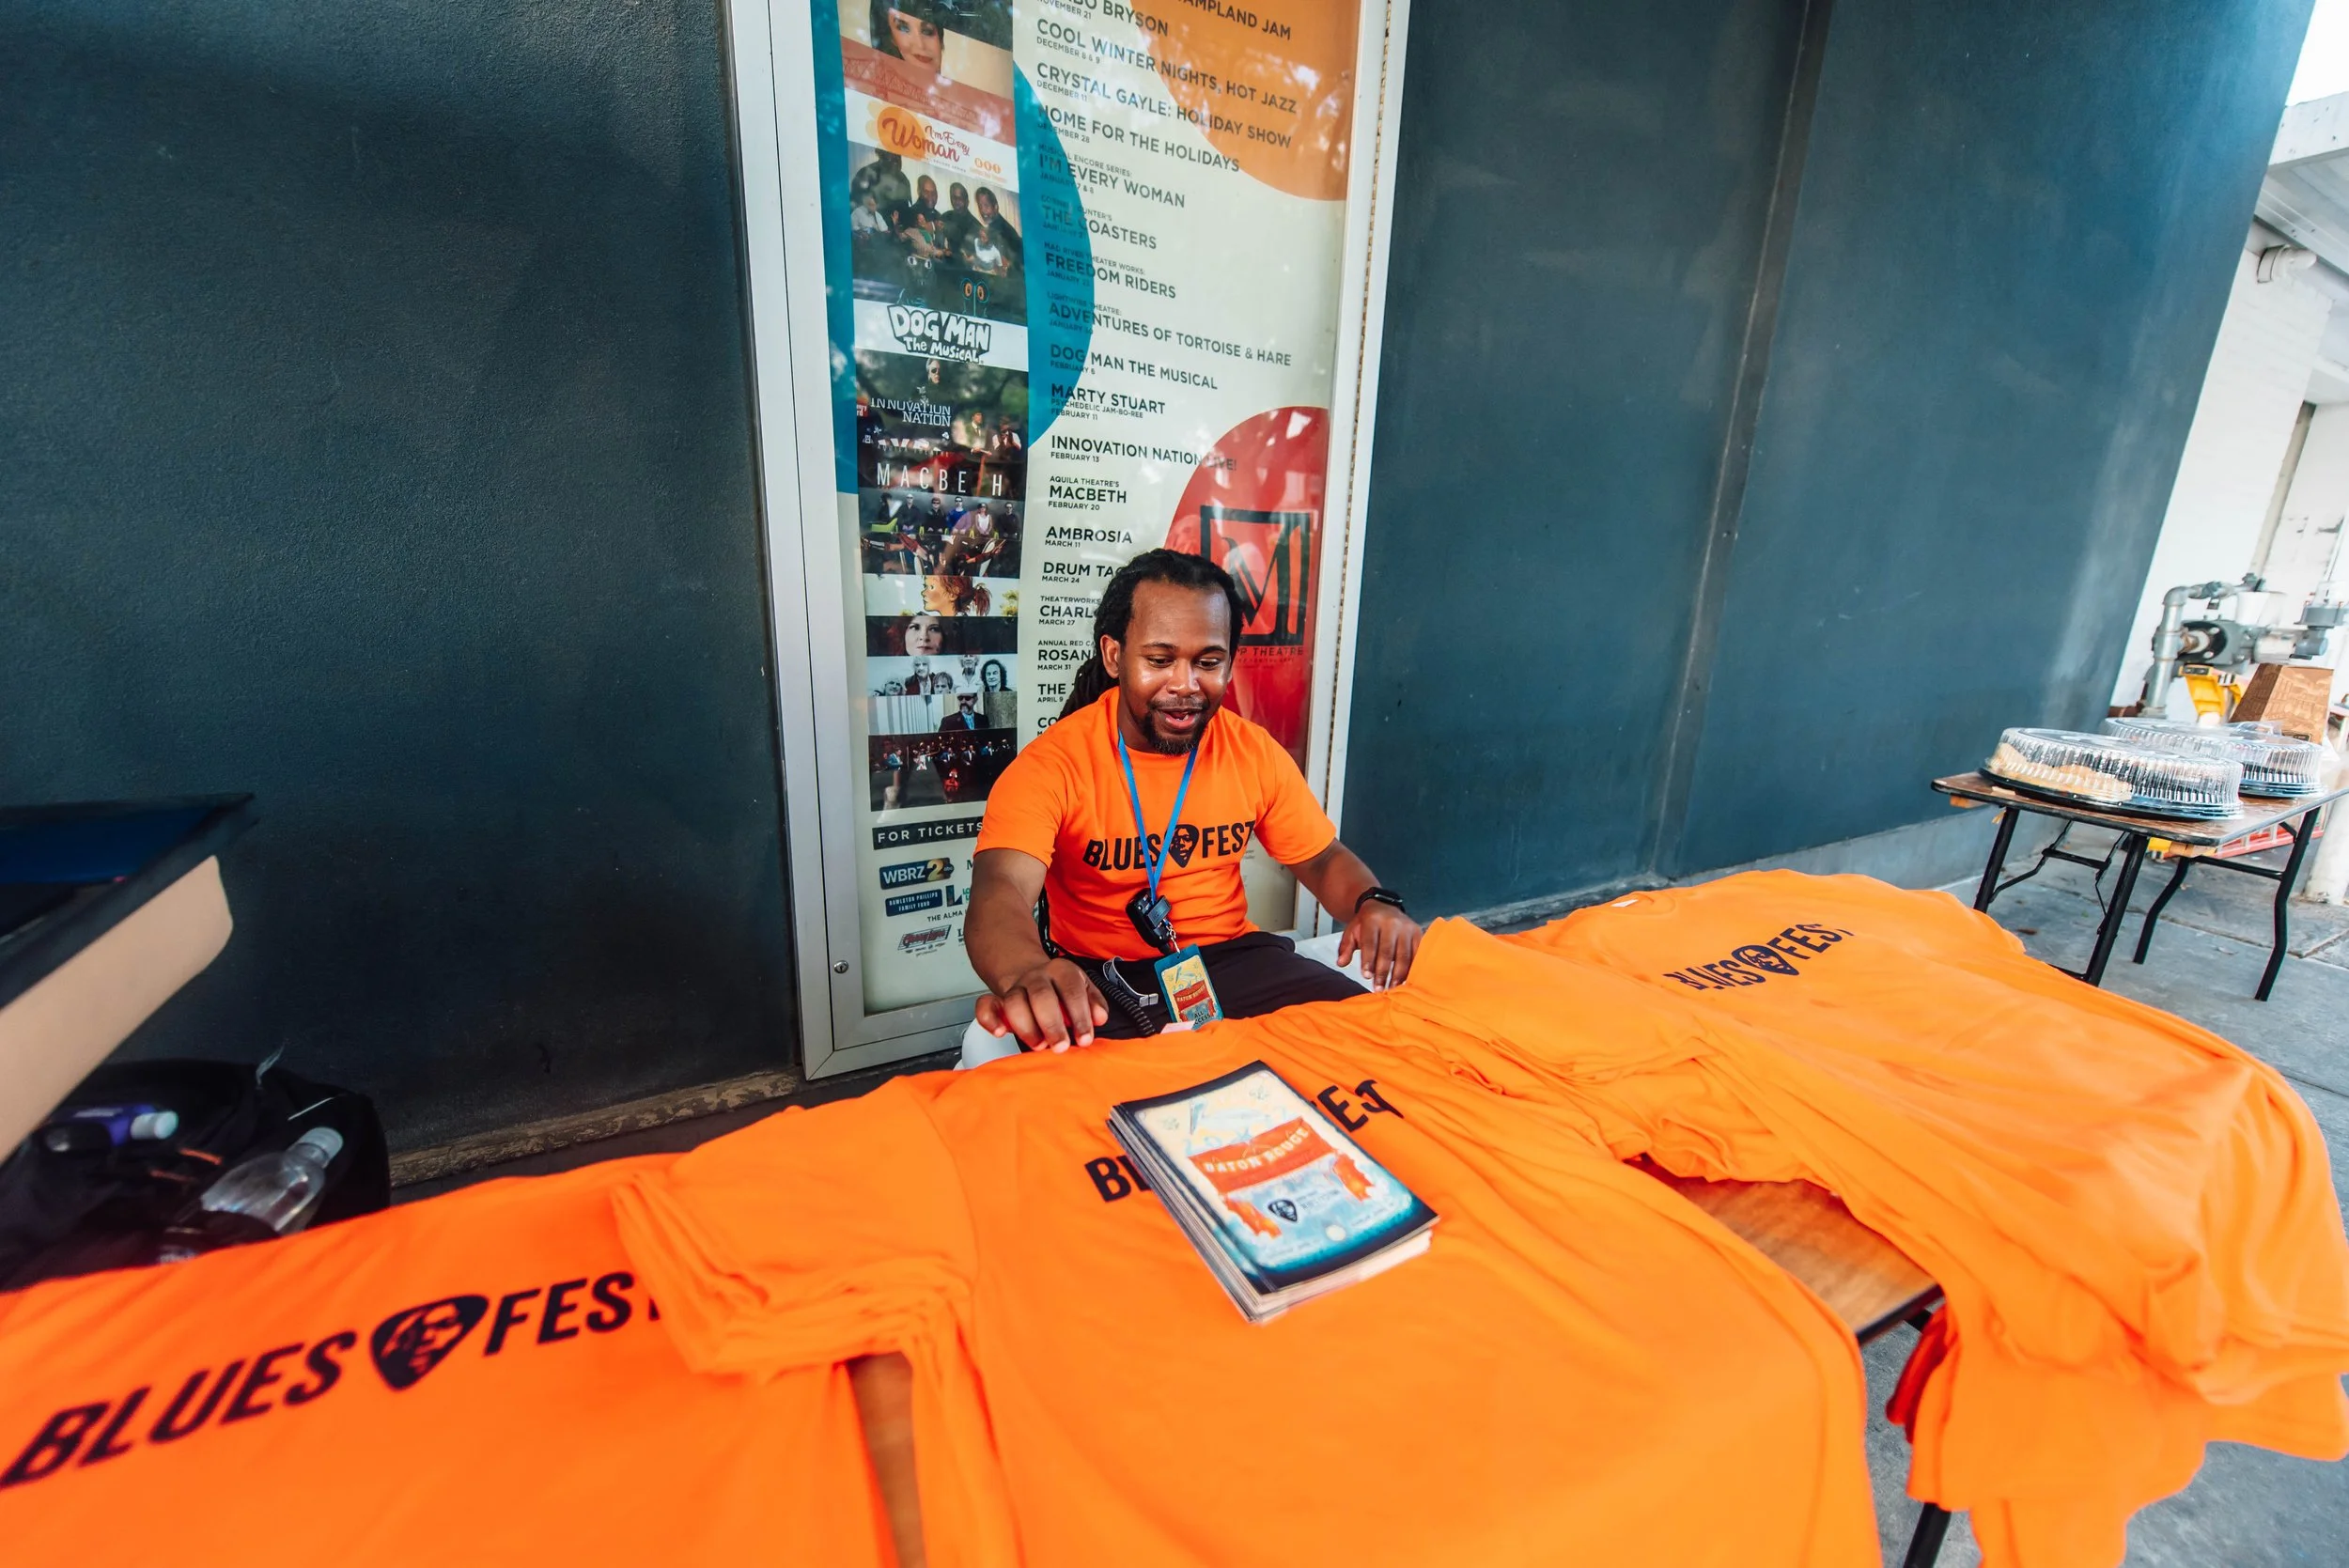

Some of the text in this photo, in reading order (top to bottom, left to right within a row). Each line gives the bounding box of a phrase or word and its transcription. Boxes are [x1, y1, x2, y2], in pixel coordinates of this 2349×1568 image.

[1103, 1, 1168, 37] BRYSON
[1262, 19, 1291, 40] JAM
[1037, 37, 1079, 56] DECEMBER
[1037, 18, 1297, 114] COOL WINTER NIGHTS, HOT JAZZ
[1037, 80, 1079, 99] DECEMBER
[1037, 62, 1292, 148] CRYSTAL GAYLE: HOLIDAY SHOW
[882, 117, 959, 163] Woman
[1038, 104, 1239, 172] HOME FOR THE HOLIDAYS
[1074, 154, 1104, 169] ENCORE
[1039, 153, 1186, 208] I'M EVERY WOMAN
[1043, 205, 1157, 249] THE COASTERS
[1084, 253, 1116, 268] THEATER
[1046, 252, 1175, 299] FREEDOM RIDERS
[888, 304, 991, 351] DOG MAN
[1050, 302, 1292, 366] ADVENTURES OF TORTOISE & HARE
[903, 336, 927, 351] The
[1050, 344, 1218, 390] DOG MAN THE MUSICAL
[1050, 361, 1089, 373] FEBRUARY
[1051, 383, 1165, 415] MARTY STUART
[1050, 399, 1143, 419] PSYCHEDELIC JAM-BO-REE
[1051, 408, 1090, 420] FEBRUARY
[902, 411, 952, 427] NATION
[1050, 452, 1091, 462] FEBRUARY
[1051, 435, 1147, 458] INNOVATION
[1152, 447, 1202, 466] NATION
[1050, 475, 1119, 488] AQUILA THEATRE'S
[1050, 485, 1127, 504] MACBETH
[1048, 501, 1089, 510] FEBRUARY
[1046, 526, 1132, 544] AMBROSIA
[1043, 562, 1090, 576] DRUM
[1040, 605, 1094, 618] CHARL
[1253, 646, 1304, 656] THEATRE
[1037, 684, 1066, 694] THE
[878, 821, 983, 843] FOR TICKETS
[1082, 820, 1255, 871] BLUES FEST
[883, 865, 926, 883] WBRZ
[926, 859, 944, 881] 2
[943, 910, 963, 919] ALMA
[1195, 1013, 1211, 1024] CCESS
[0, 1329, 359, 1491] BLUES
